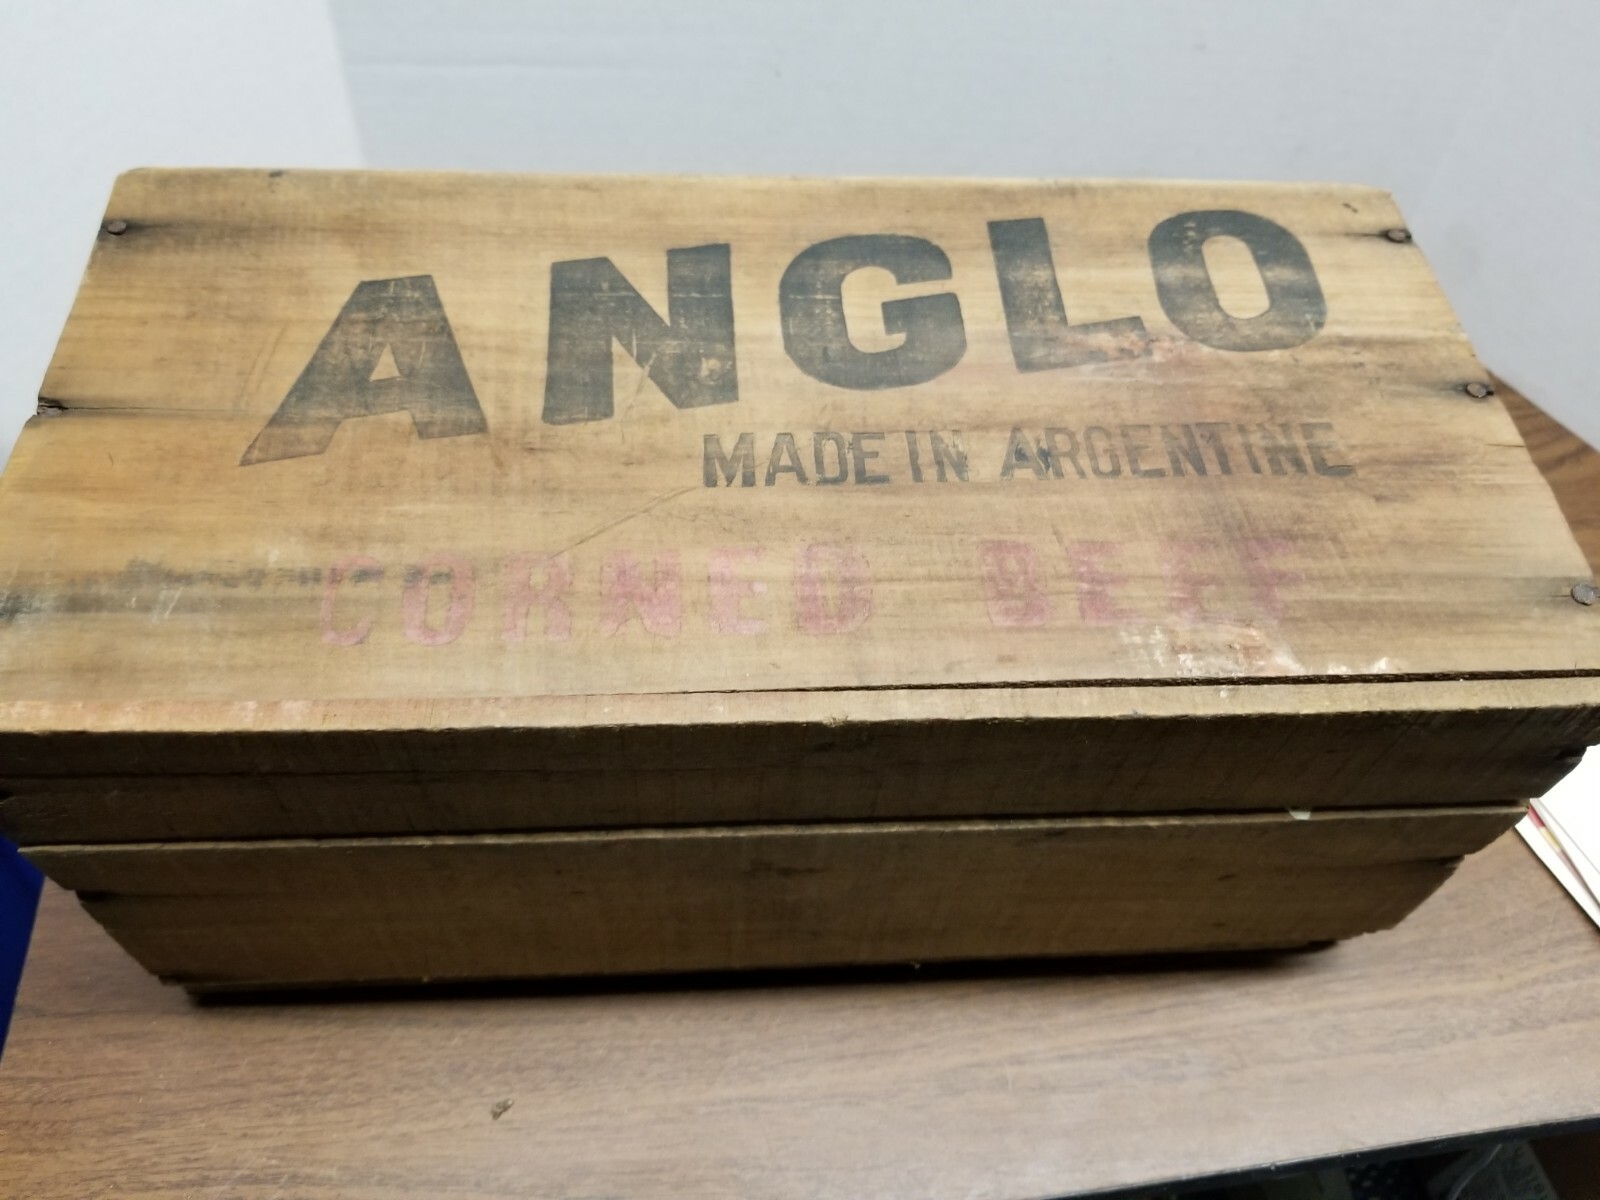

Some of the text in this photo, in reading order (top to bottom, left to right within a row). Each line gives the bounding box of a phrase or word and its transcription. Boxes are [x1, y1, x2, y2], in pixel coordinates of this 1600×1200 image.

[239, 209, 1328, 466] ANGLO
[703, 421, 1354, 487] MADE IN ARGENTINE
[318, 536, 1301, 647] CORNED BEEF
